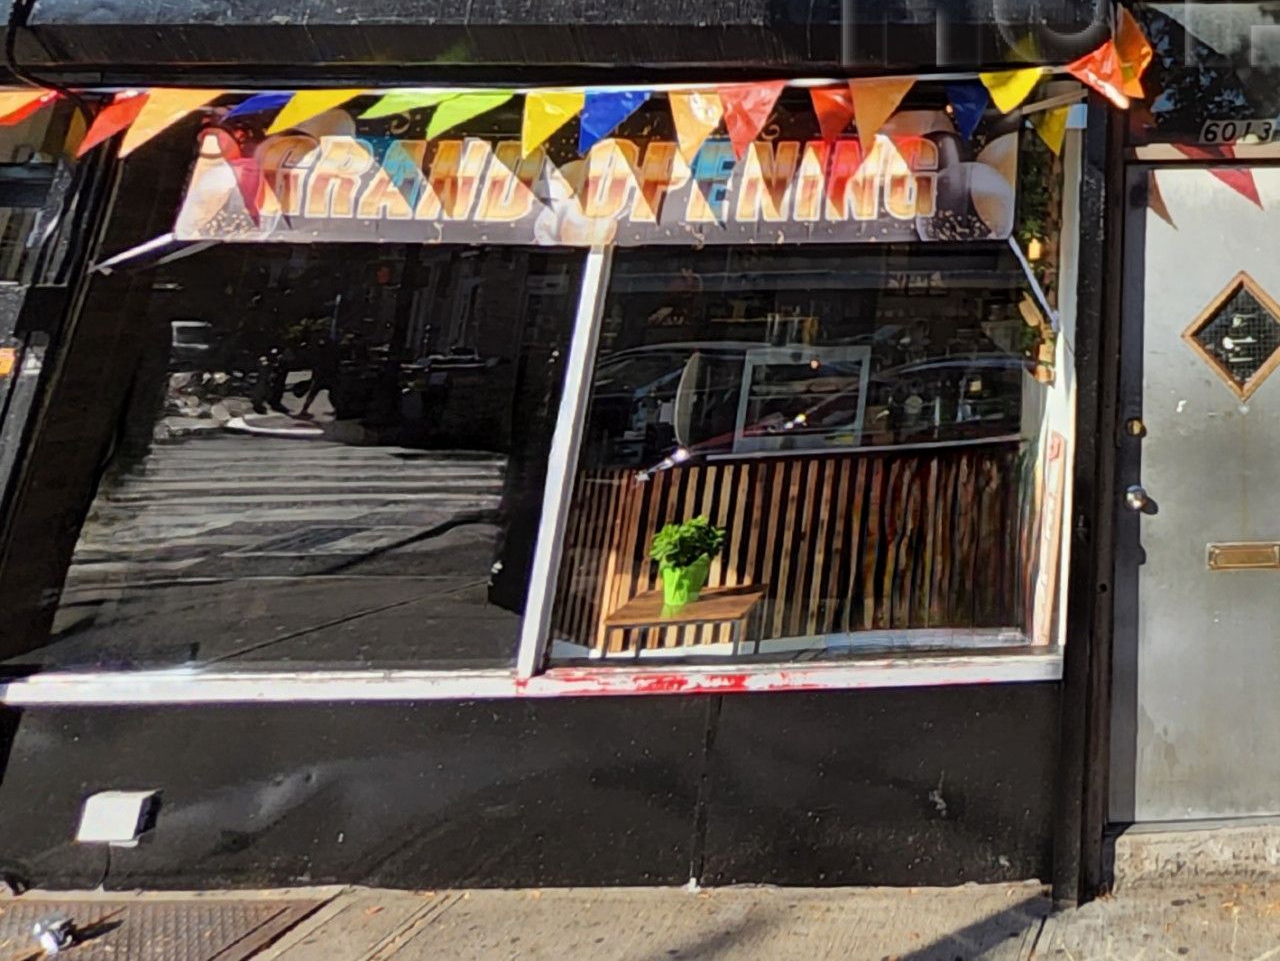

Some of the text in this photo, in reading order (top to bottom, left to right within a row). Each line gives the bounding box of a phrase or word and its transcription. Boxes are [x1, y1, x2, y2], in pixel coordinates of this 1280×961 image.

[1203, 121, 1273, 143] 6013
[257, 134, 939, 223] GRAND OPENING
